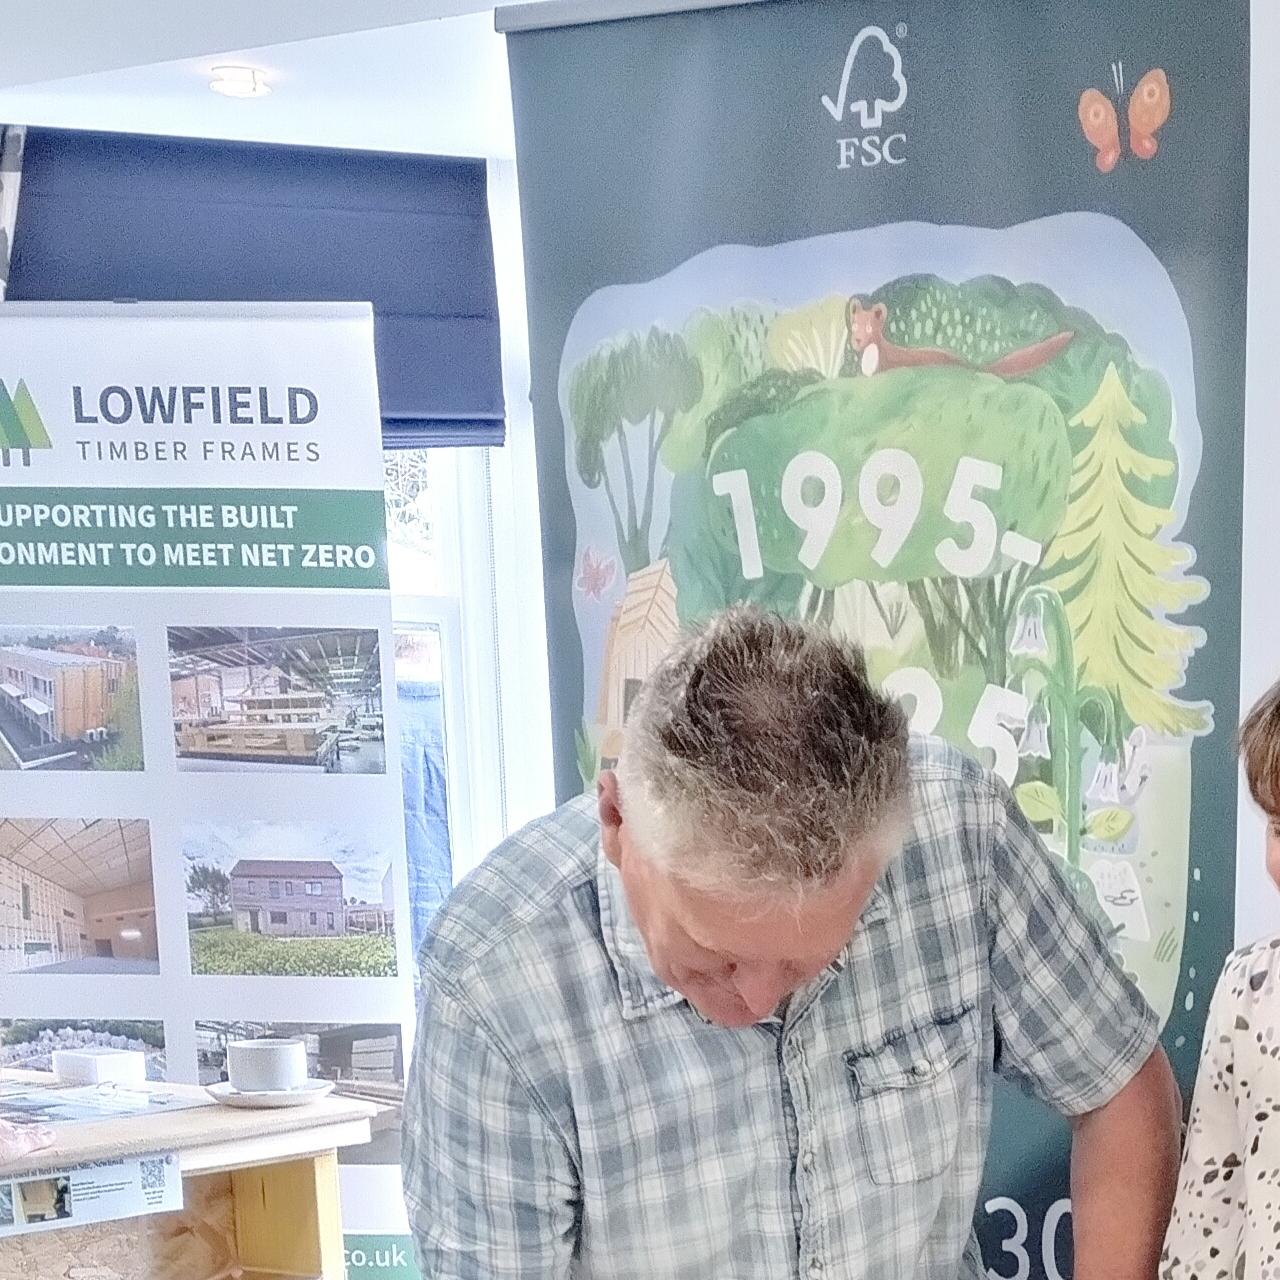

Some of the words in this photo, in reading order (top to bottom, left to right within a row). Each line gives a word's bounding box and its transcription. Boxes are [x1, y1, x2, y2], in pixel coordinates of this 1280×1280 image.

[837, 133, 907, 170] FSC
[72, 385, 319, 426] LOWFIELD
[76, 440, 188, 462] TIMBER
[202, 441, 321, 462] FRAMES
[162, 504, 214, 528] THE
[222, 505, 298, 528] BUILT
[121, 543, 157, 567] TO
[164, 543, 235, 567] MEET
[241, 544, 294, 567] NET
[301, 545, 375, 569] ZERO
